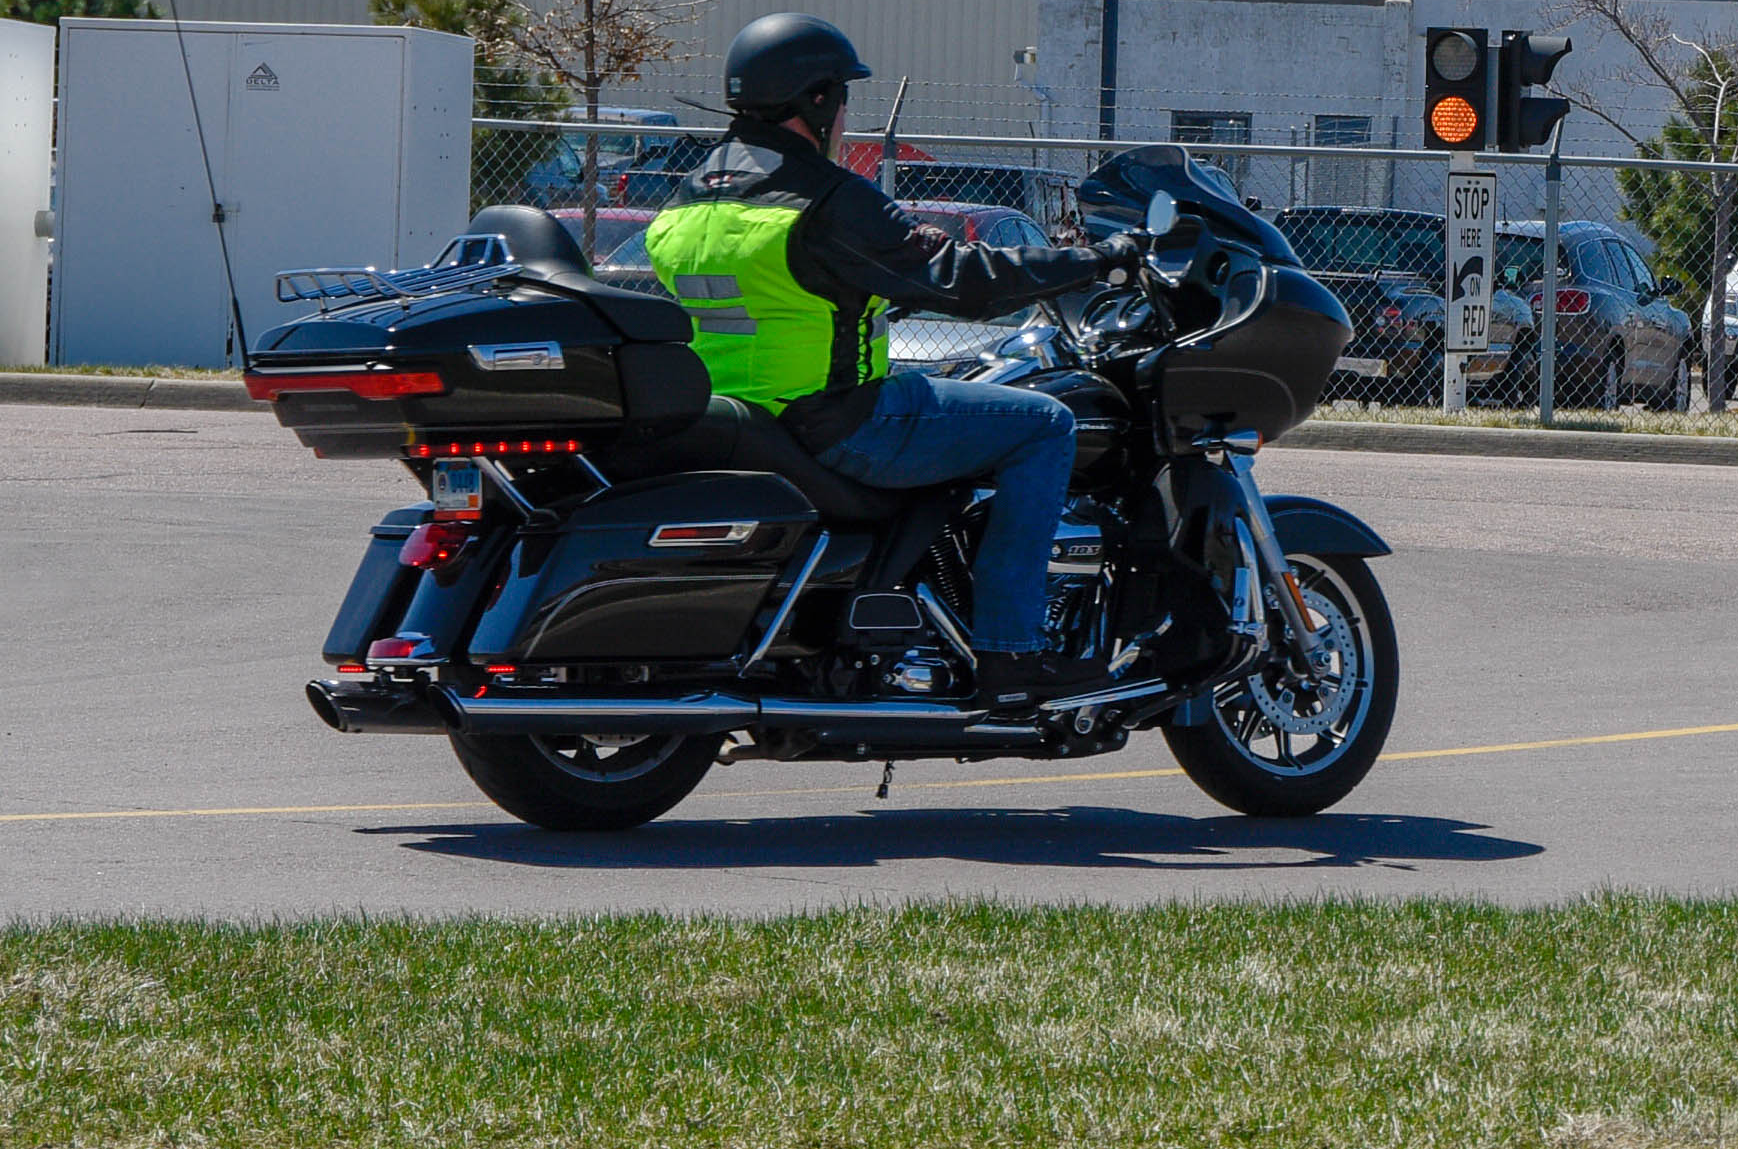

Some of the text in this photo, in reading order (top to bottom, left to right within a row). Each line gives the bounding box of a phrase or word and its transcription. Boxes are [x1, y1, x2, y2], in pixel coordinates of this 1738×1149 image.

[245, 78, 280, 86] DELTA
[1454, 187, 1490, 221] STOP
[1460, 228, 1482, 248] HERE
[1469, 277, 1481, 297] ON
[1462, 305, 1486, 337] RED
